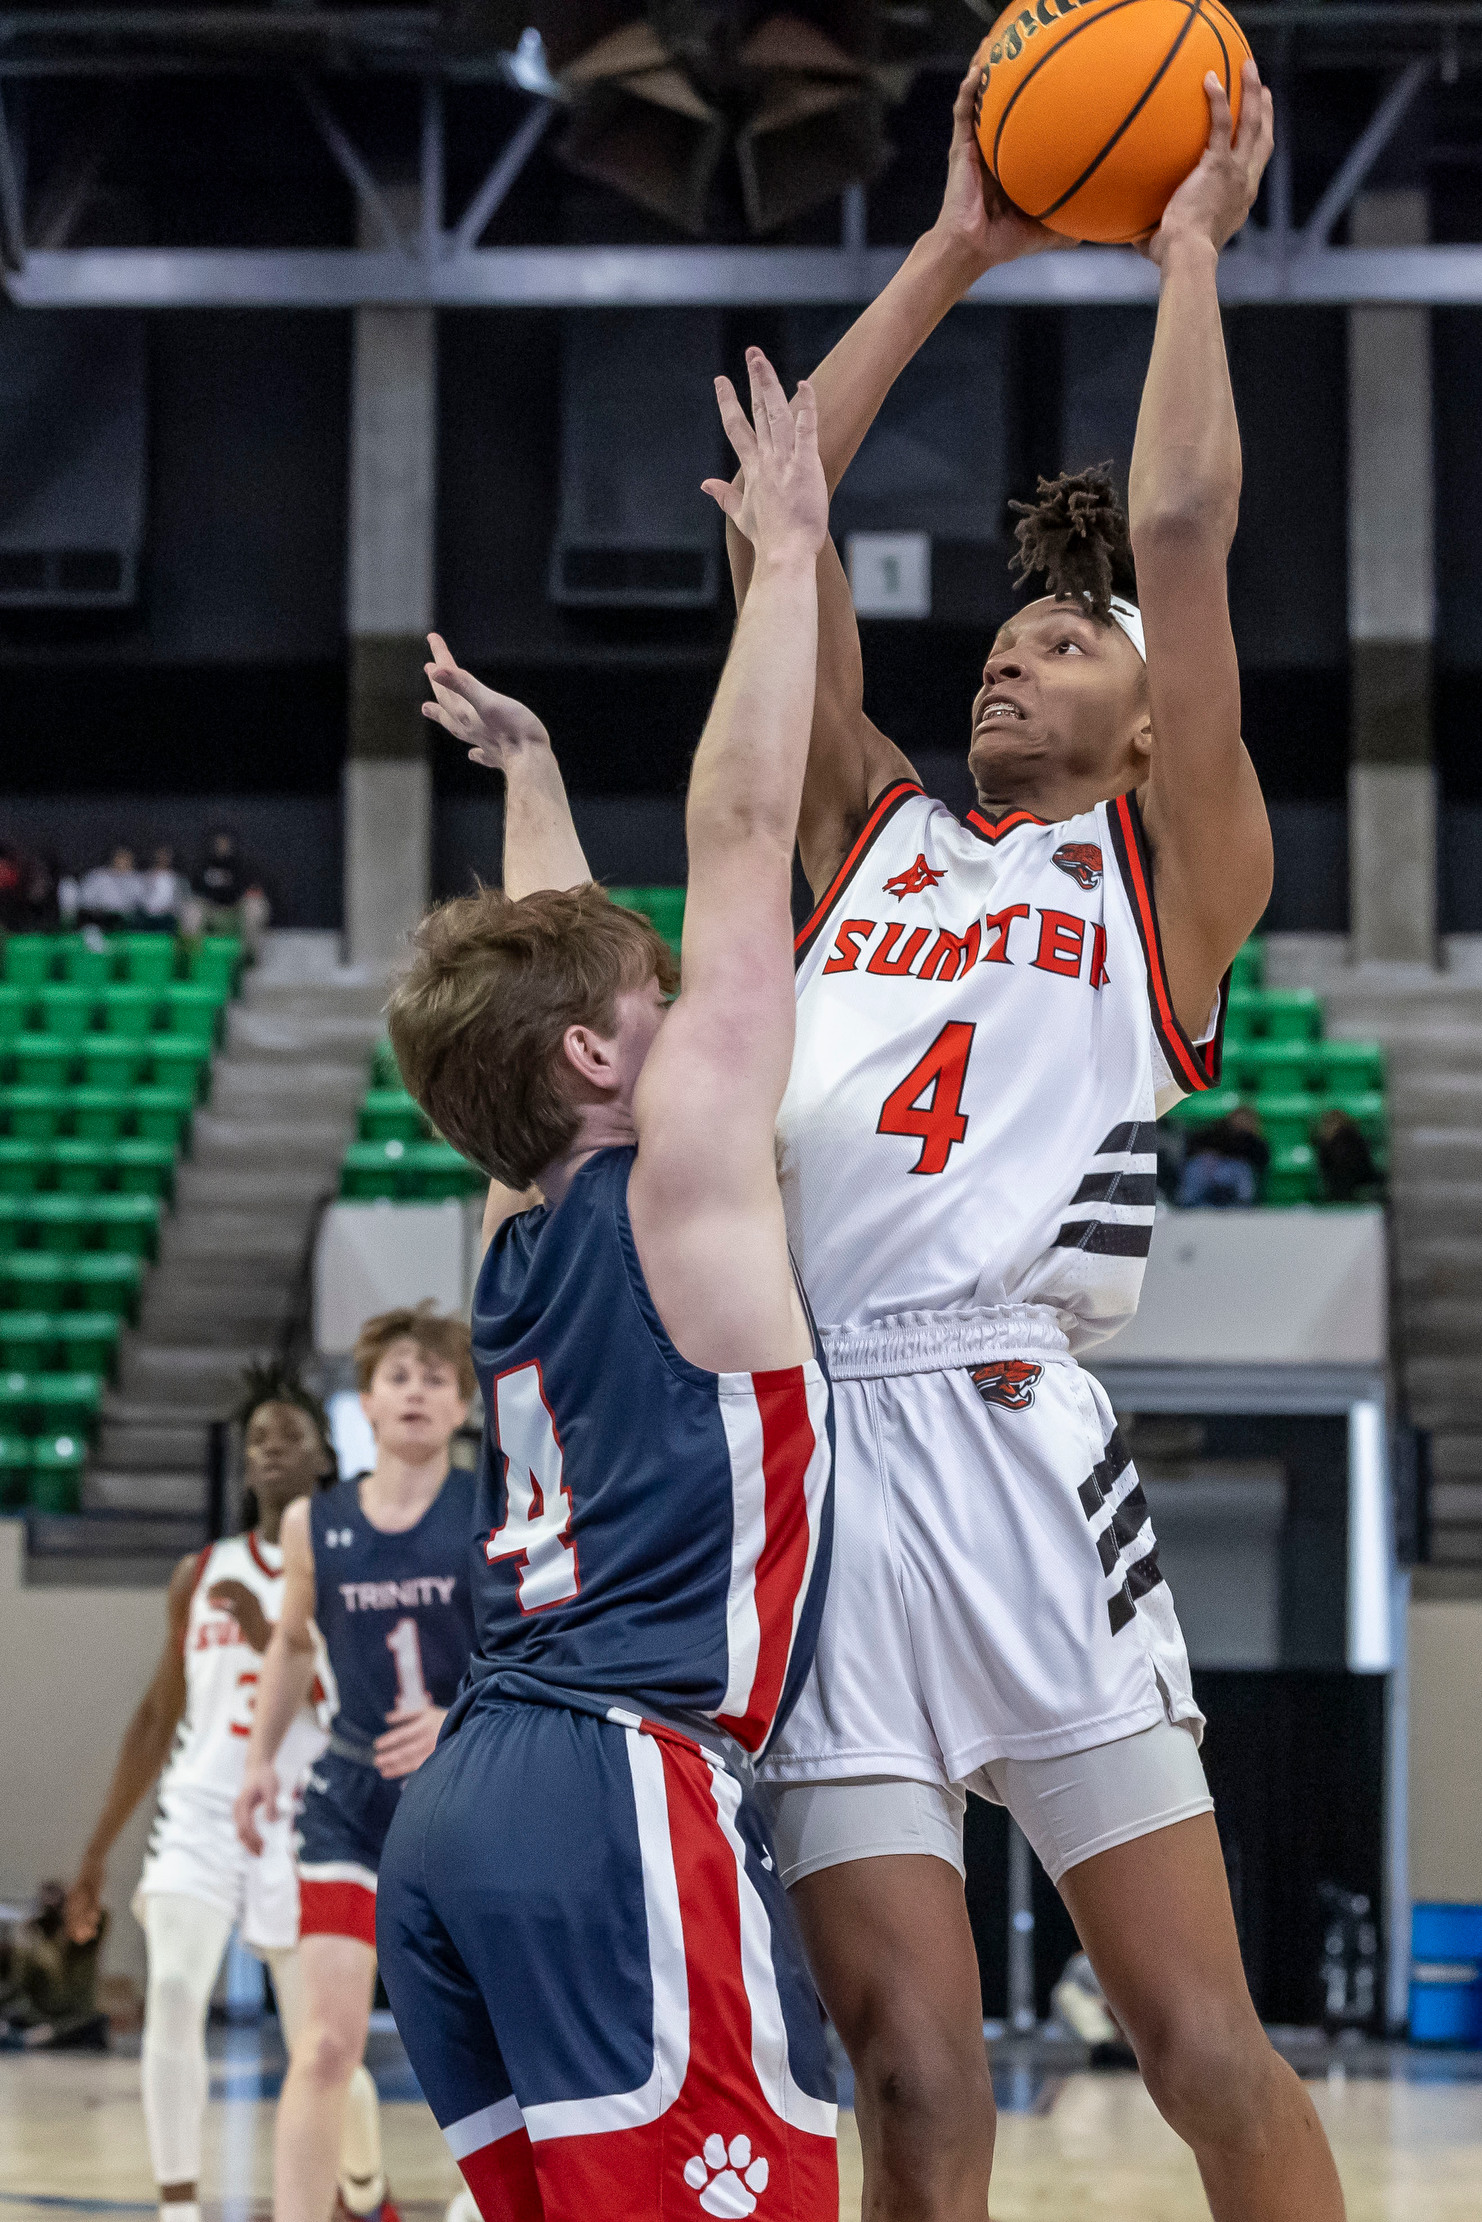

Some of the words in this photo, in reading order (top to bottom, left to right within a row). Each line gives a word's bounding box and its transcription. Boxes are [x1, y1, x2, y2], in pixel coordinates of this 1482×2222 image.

[875, 1020, 977, 1175] 4
[484, 1358, 580, 1617] 4
[338, 1576, 456, 1613] TRINITY
[386, 1617, 434, 1715] 1
